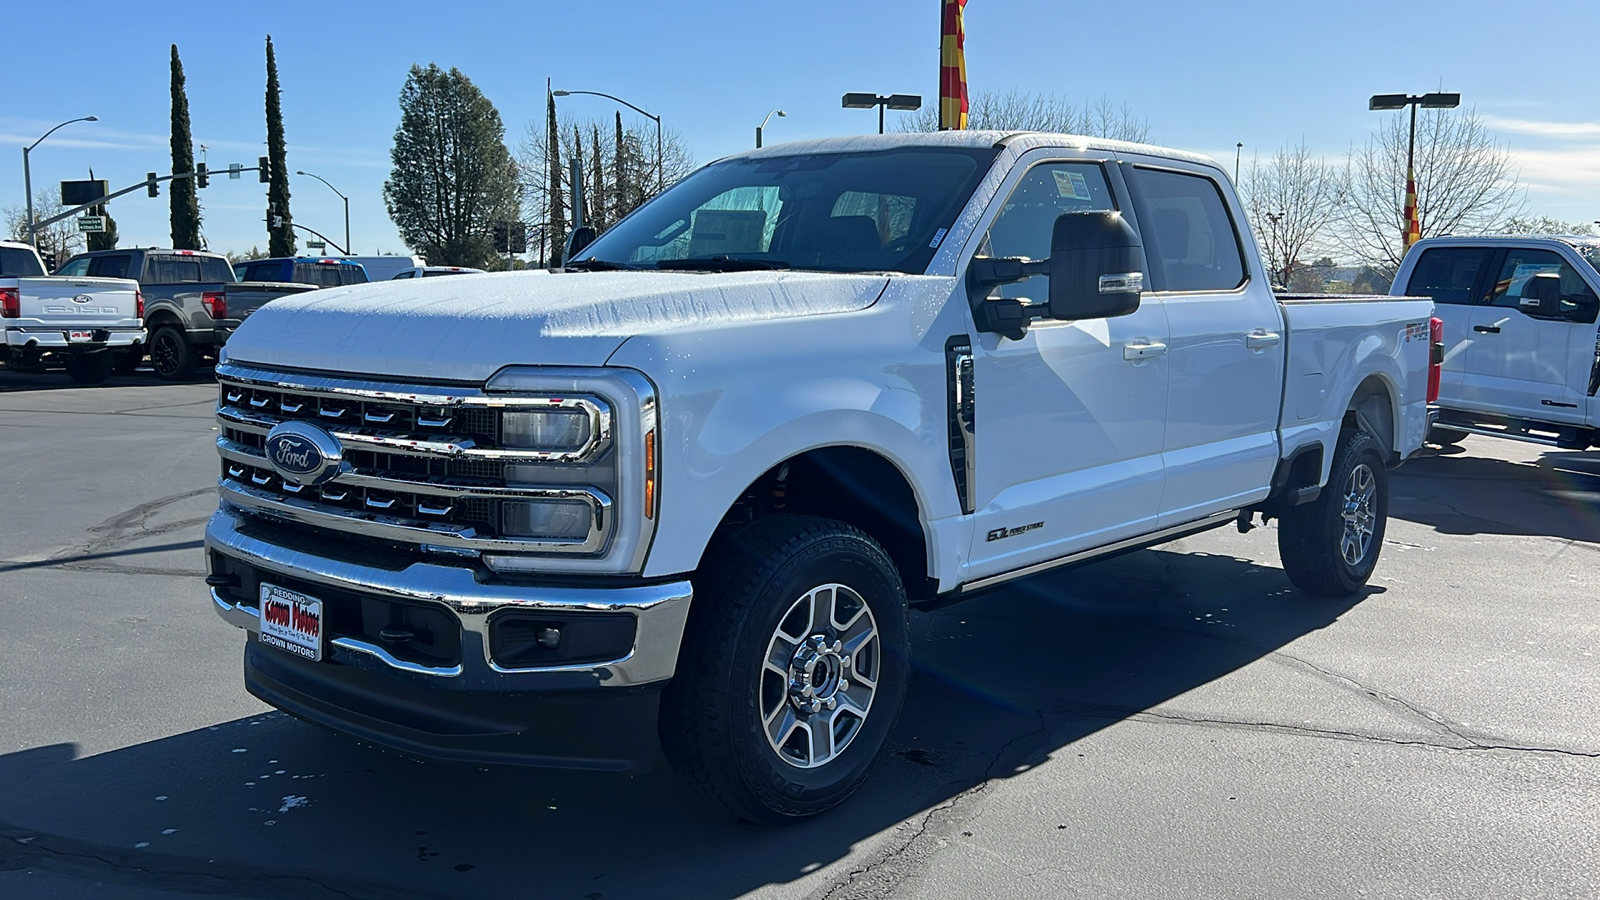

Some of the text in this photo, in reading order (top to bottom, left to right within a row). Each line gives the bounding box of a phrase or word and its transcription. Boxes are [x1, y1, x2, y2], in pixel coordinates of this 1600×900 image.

[43, 305, 118, 315] F-150
[276, 438, 310, 468] Ford
[274, 588, 305, 603] REDDING
[265, 601, 319, 637] Crown Motors
[262, 634, 314, 658] CROWN MOTORS
